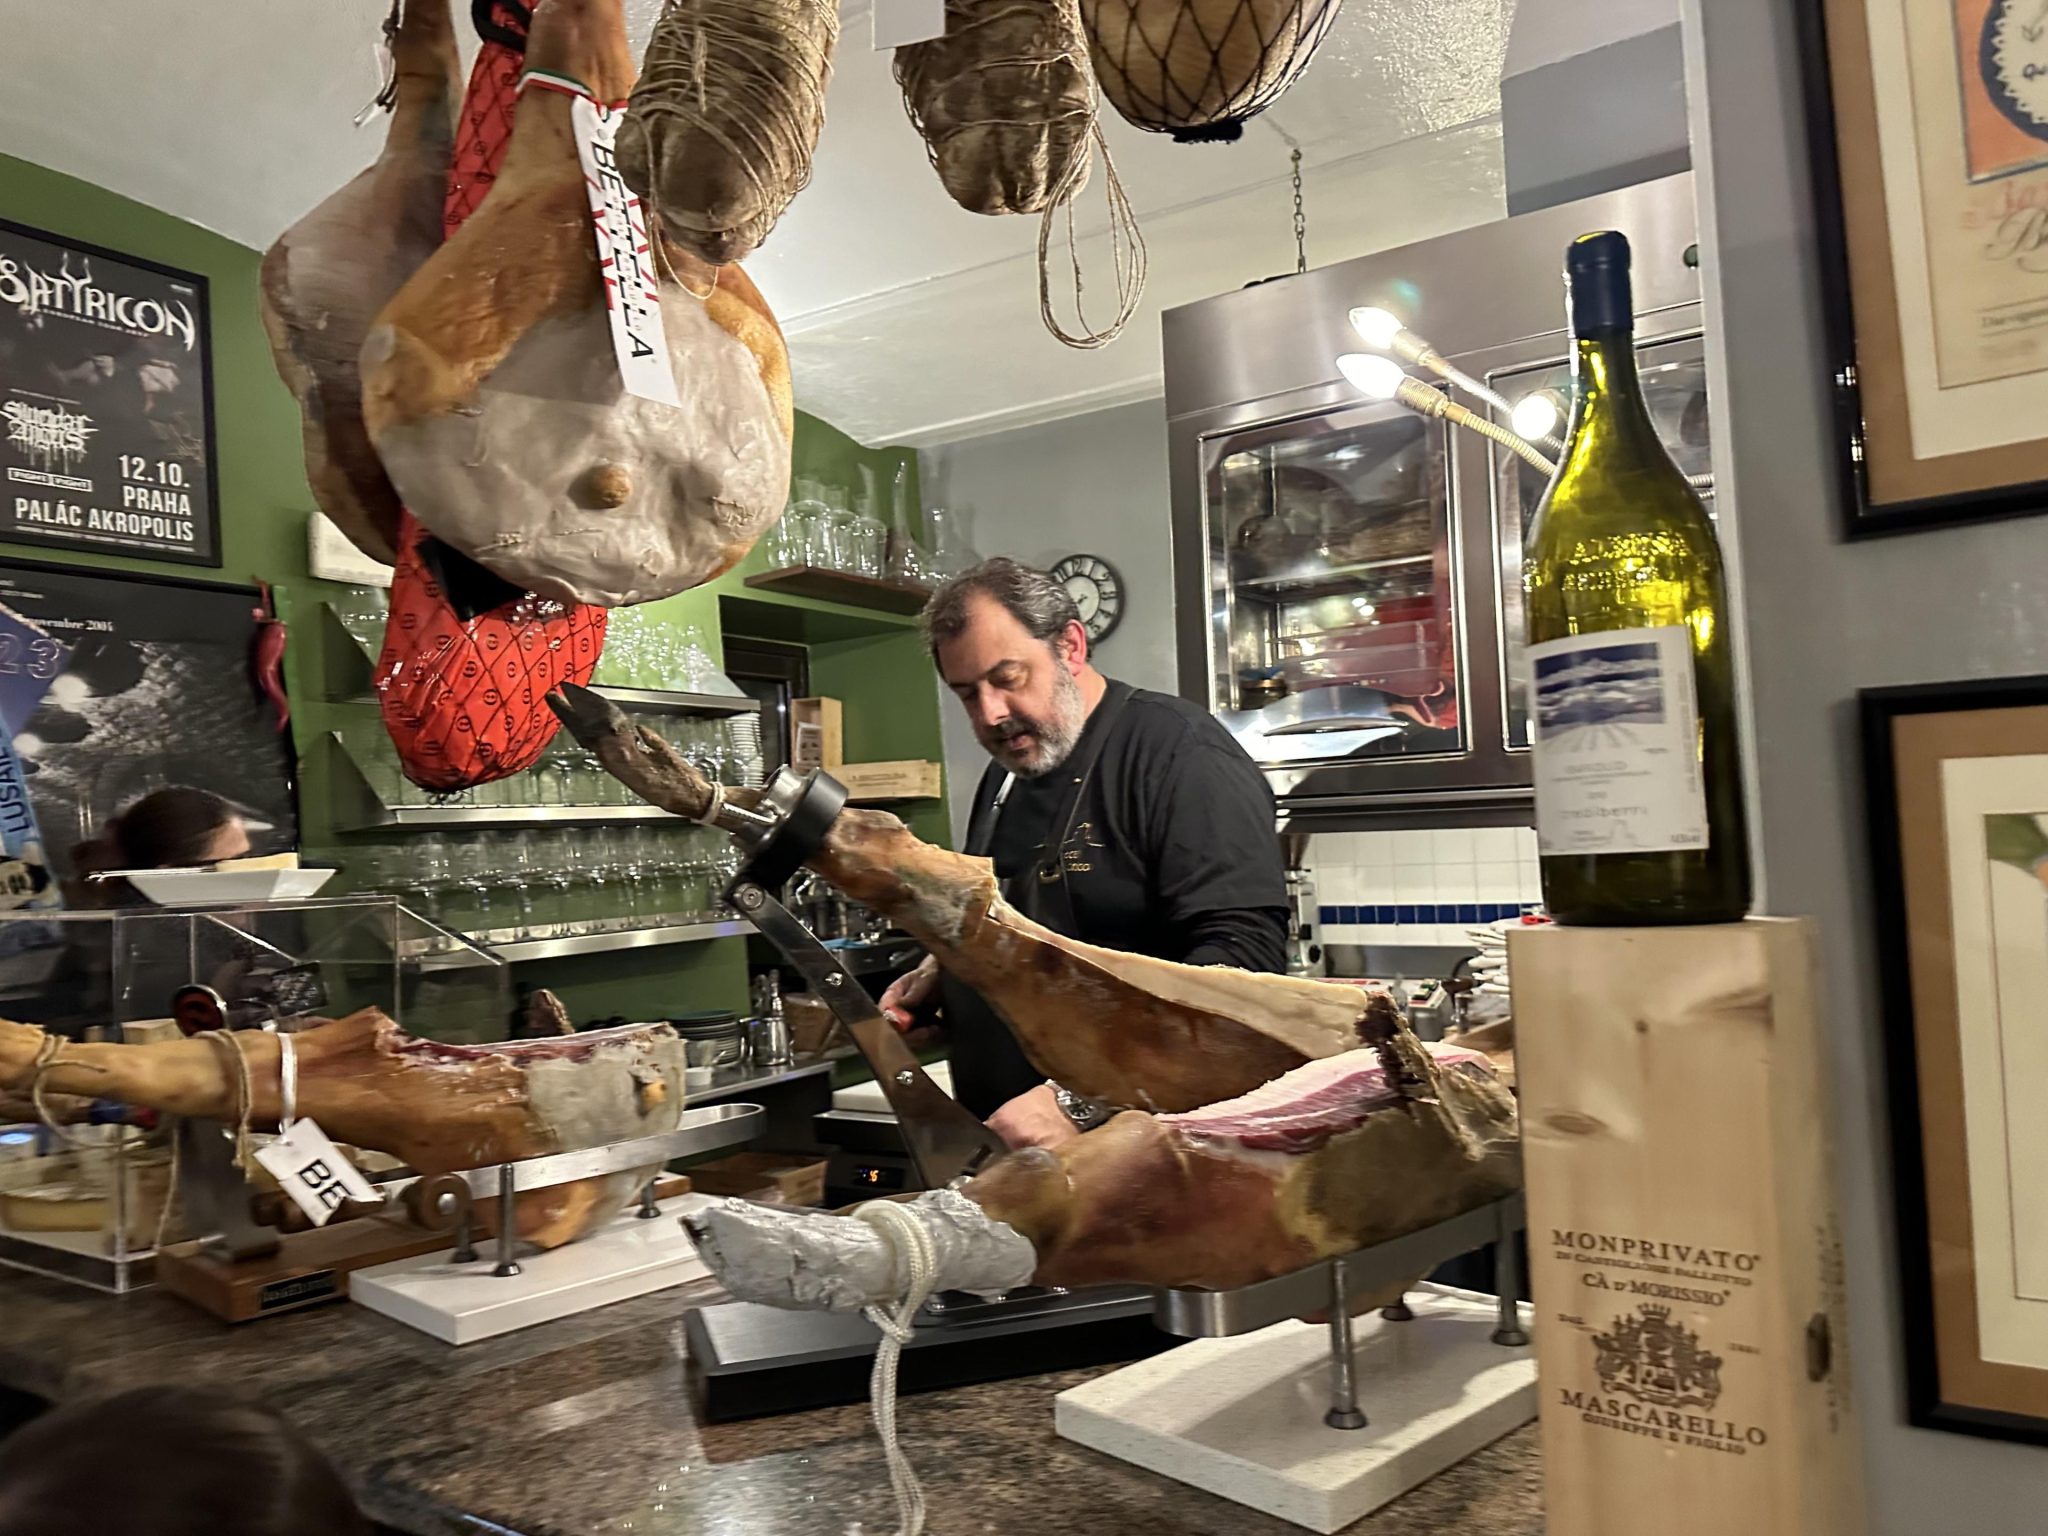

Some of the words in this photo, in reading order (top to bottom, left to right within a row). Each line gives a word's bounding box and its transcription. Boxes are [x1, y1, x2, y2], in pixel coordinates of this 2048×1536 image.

[0, 251, 195, 351] SATYRICON
[119, 455, 190, 487] 12.10.
[15, 497, 82, 527] PALÁC
[88, 508, 193, 541] AKROPOLIS
[123, 485, 192, 516] PRAHA
[1552, 1229, 1755, 1272] MONPRIVATO
[1559, 1388, 1767, 1446] MASCARELLO
